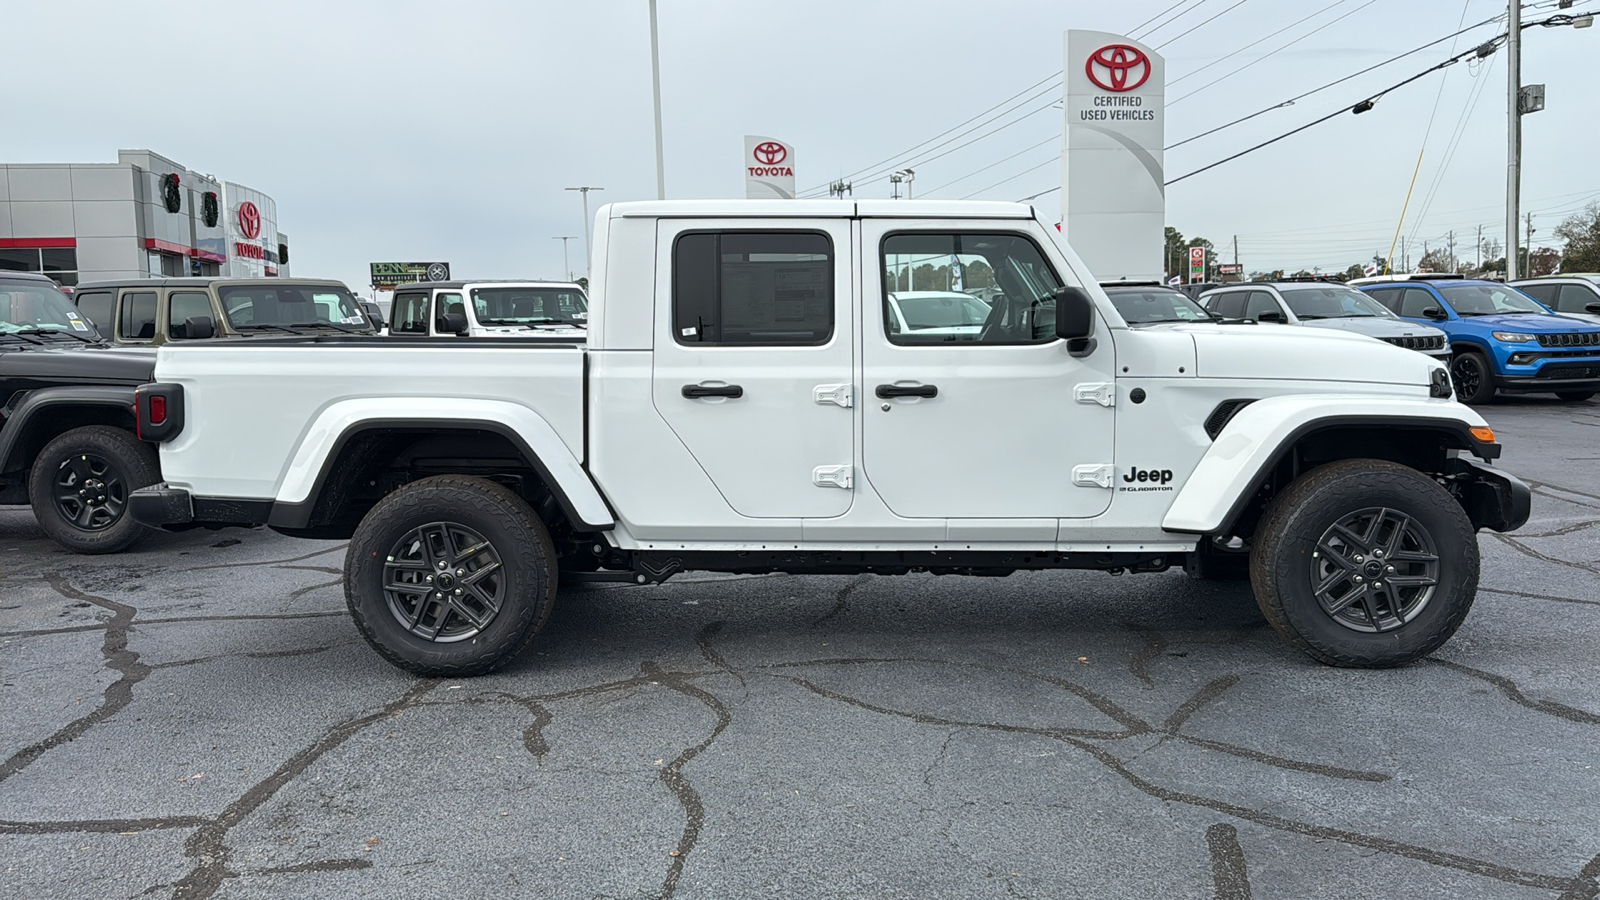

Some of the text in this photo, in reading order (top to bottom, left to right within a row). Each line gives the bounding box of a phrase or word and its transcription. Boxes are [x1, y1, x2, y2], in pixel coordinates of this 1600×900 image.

[1093, 96, 1142, 107] CERTIFIED
[1080, 110, 1154, 121] USED VEHICLES
[748, 167, 793, 176] TOYOTA
[235, 242, 264, 260] TOYOTA
[373, 263, 405, 273] PENN
[1123, 466, 1173, 485] Jeep
